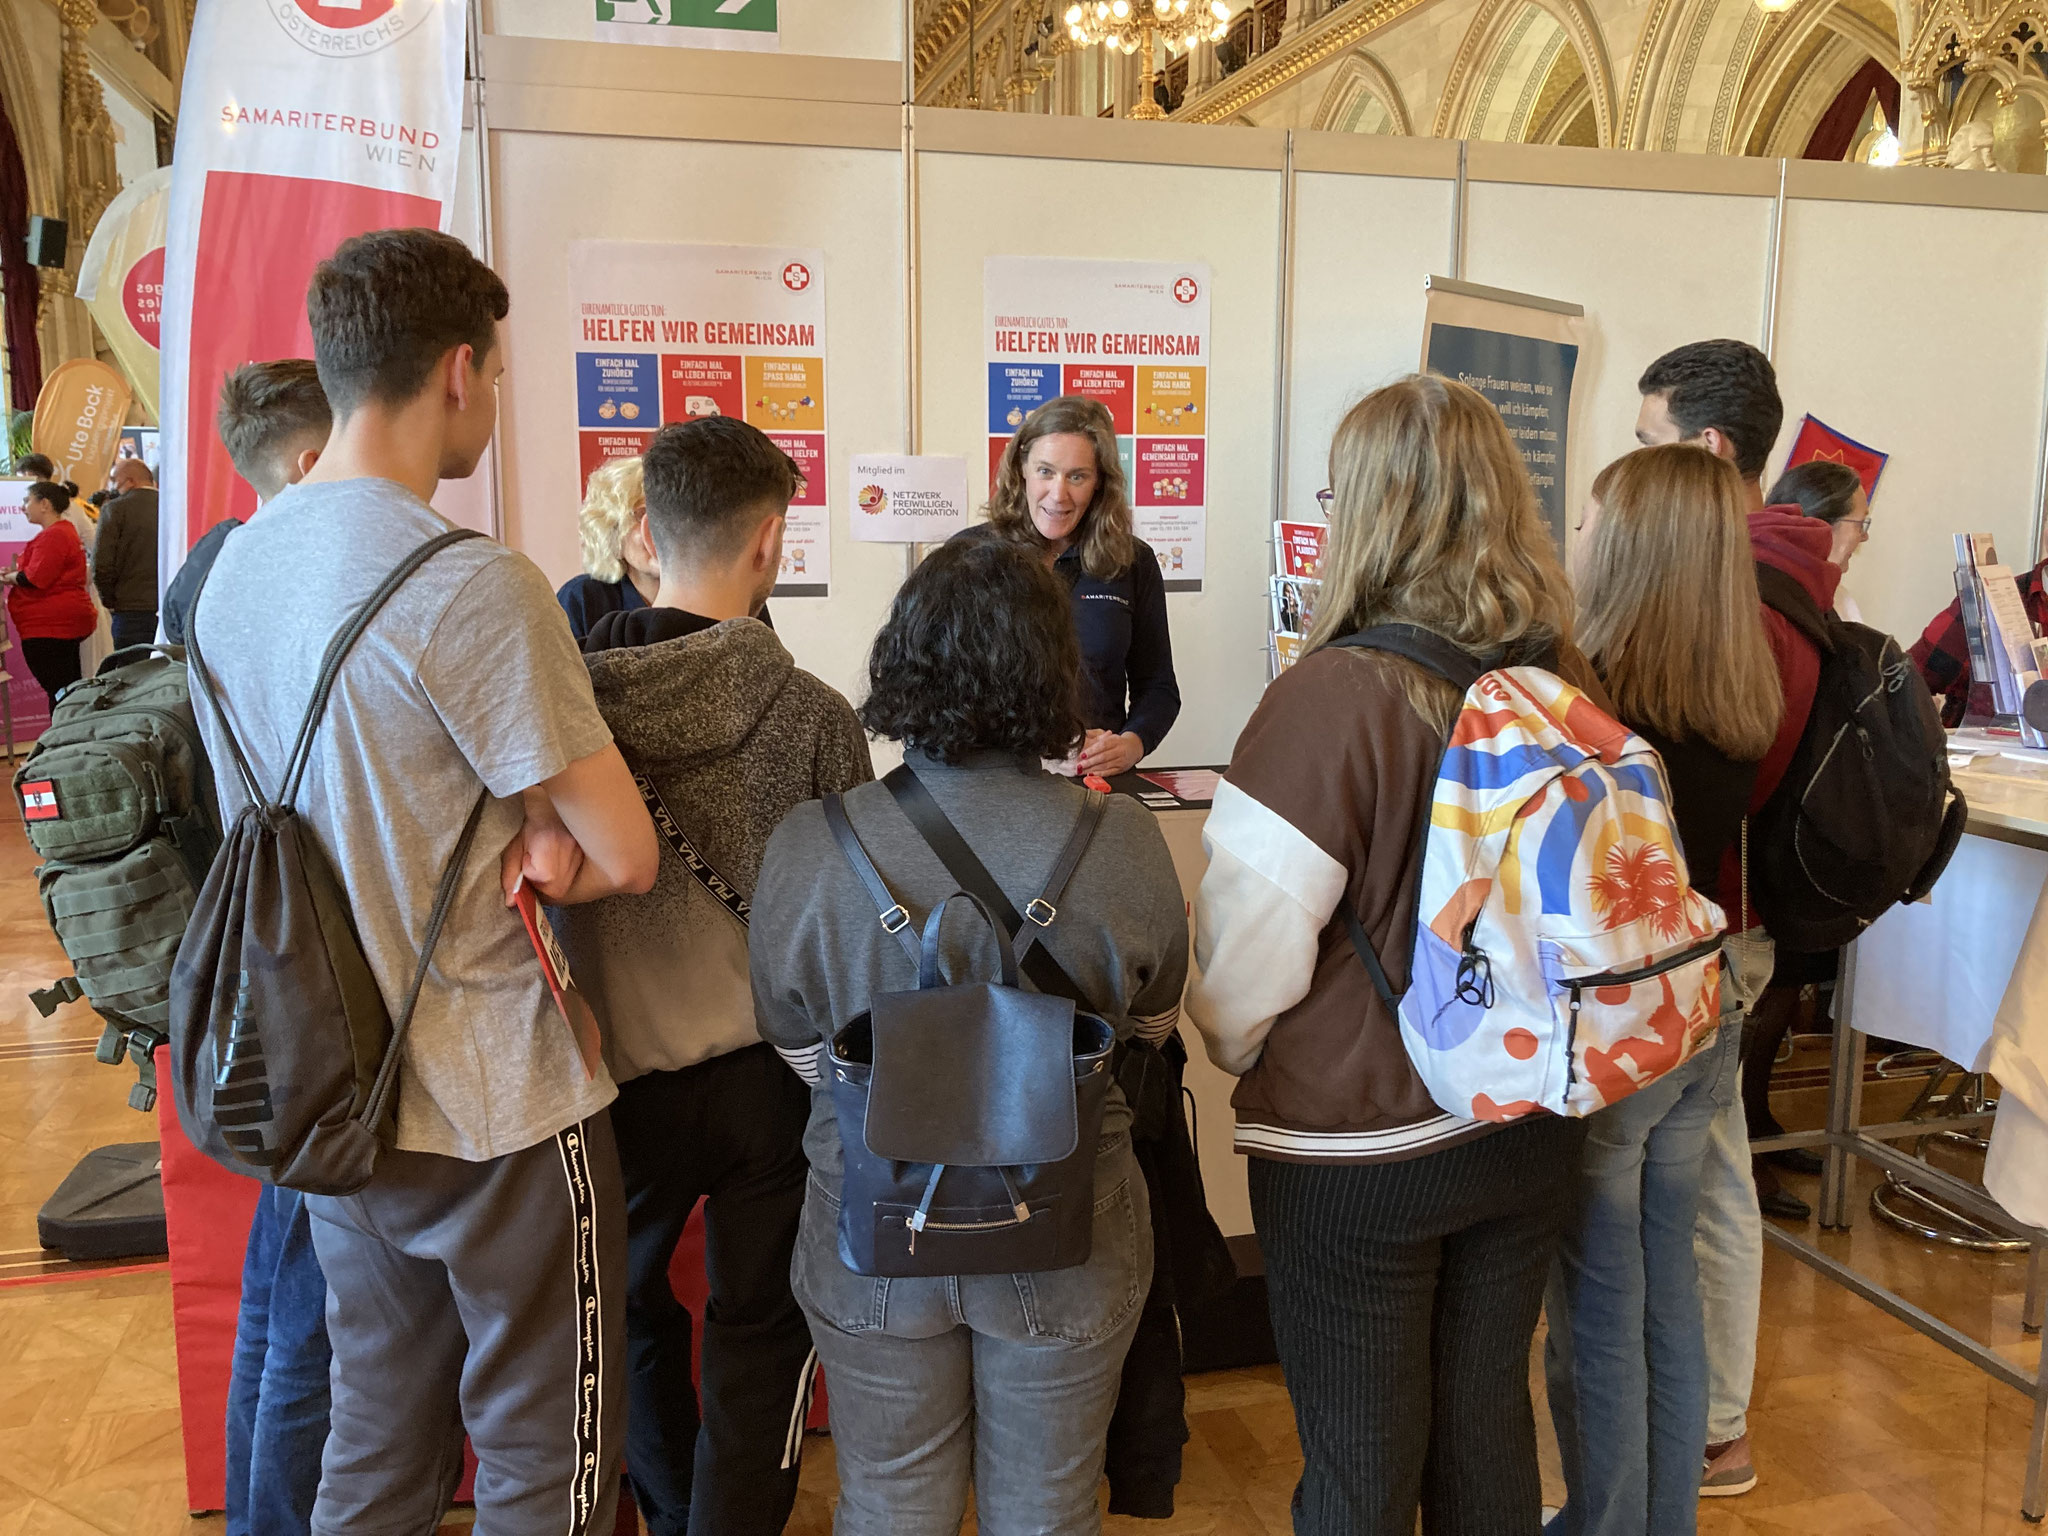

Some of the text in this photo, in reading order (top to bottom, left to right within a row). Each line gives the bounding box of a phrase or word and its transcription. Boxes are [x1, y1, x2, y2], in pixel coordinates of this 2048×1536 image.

[280, 3, 405, 50] ÖSTERREICHS
[221, 106, 439, 149] SAMARITERBUND
[366, 143, 436, 172] WIEN
[582, 304, 628, 316] EHRENAMTLICH
[629, 304, 649, 316] GUTES
[995, 316, 1036, 328] EHRENAMTLICH
[1037, 317, 1055, 328] GUTES
[583, 319, 814, 346] HELFEN WIR GEMEINSAM
[995, 331, 1200, 356] HELFEN WIR GEMEINSAM
[595, 358, 639, 368] EINFACH MAL
[680, 360, 723, 370] EINFACH MAL
[763, 362, 805, 371] EINFACH MAL
[602, 368, 633, 378] ZUHÖREN
[672, 370, 732, 380] EIN LEBEN RETTEN
[763, 372, 783, 381] SPASS
[1005, 368, 1044, 378] EINFACH MAL
[1080, 370, 1104, 378] EINFACH
[1153, 371, 1177, 379] EINFACH
[1103, 380, 1125, 388] RETTEN
[1153, 380, 1170, 388] SPASS
[1458, 372, 1486, 391] Solange
[1487, 375, 1509, 390] Frauen
[1535, 382, 1545, 394] wie
[1500, 402, 1511, 414] will
[1512, 403, 1521, 415] ich
[66, 384, 103, 461] Ute Bock
[1519, 426, 1538, 439] leiden
[598, 437, 642, 446] EINFACH MAL
[793, 440, 807, 448] MAL
[603, 447, 638, 456] PLAUDERN
[794, 450, 818, 458] HELFEN
[1152, 444, 1176, 452] EINFACH
[858, 466, 892, 476] Mitglied
[893, 500, 952, 508] FREIWILLIGEN
[654, 806, 678, 838] FILA
[679, 842, 704, 871] FILA
[708, 875, 735, 900] FILA
[566, 1133, 585, 1204] Champion
[578, 1216, 590, 1284] Champion
[582, 1296, 596, 1362] Champion
[581, 1373, 596, 1439] Champion
[576, 1452, 595, 1526] Champion
